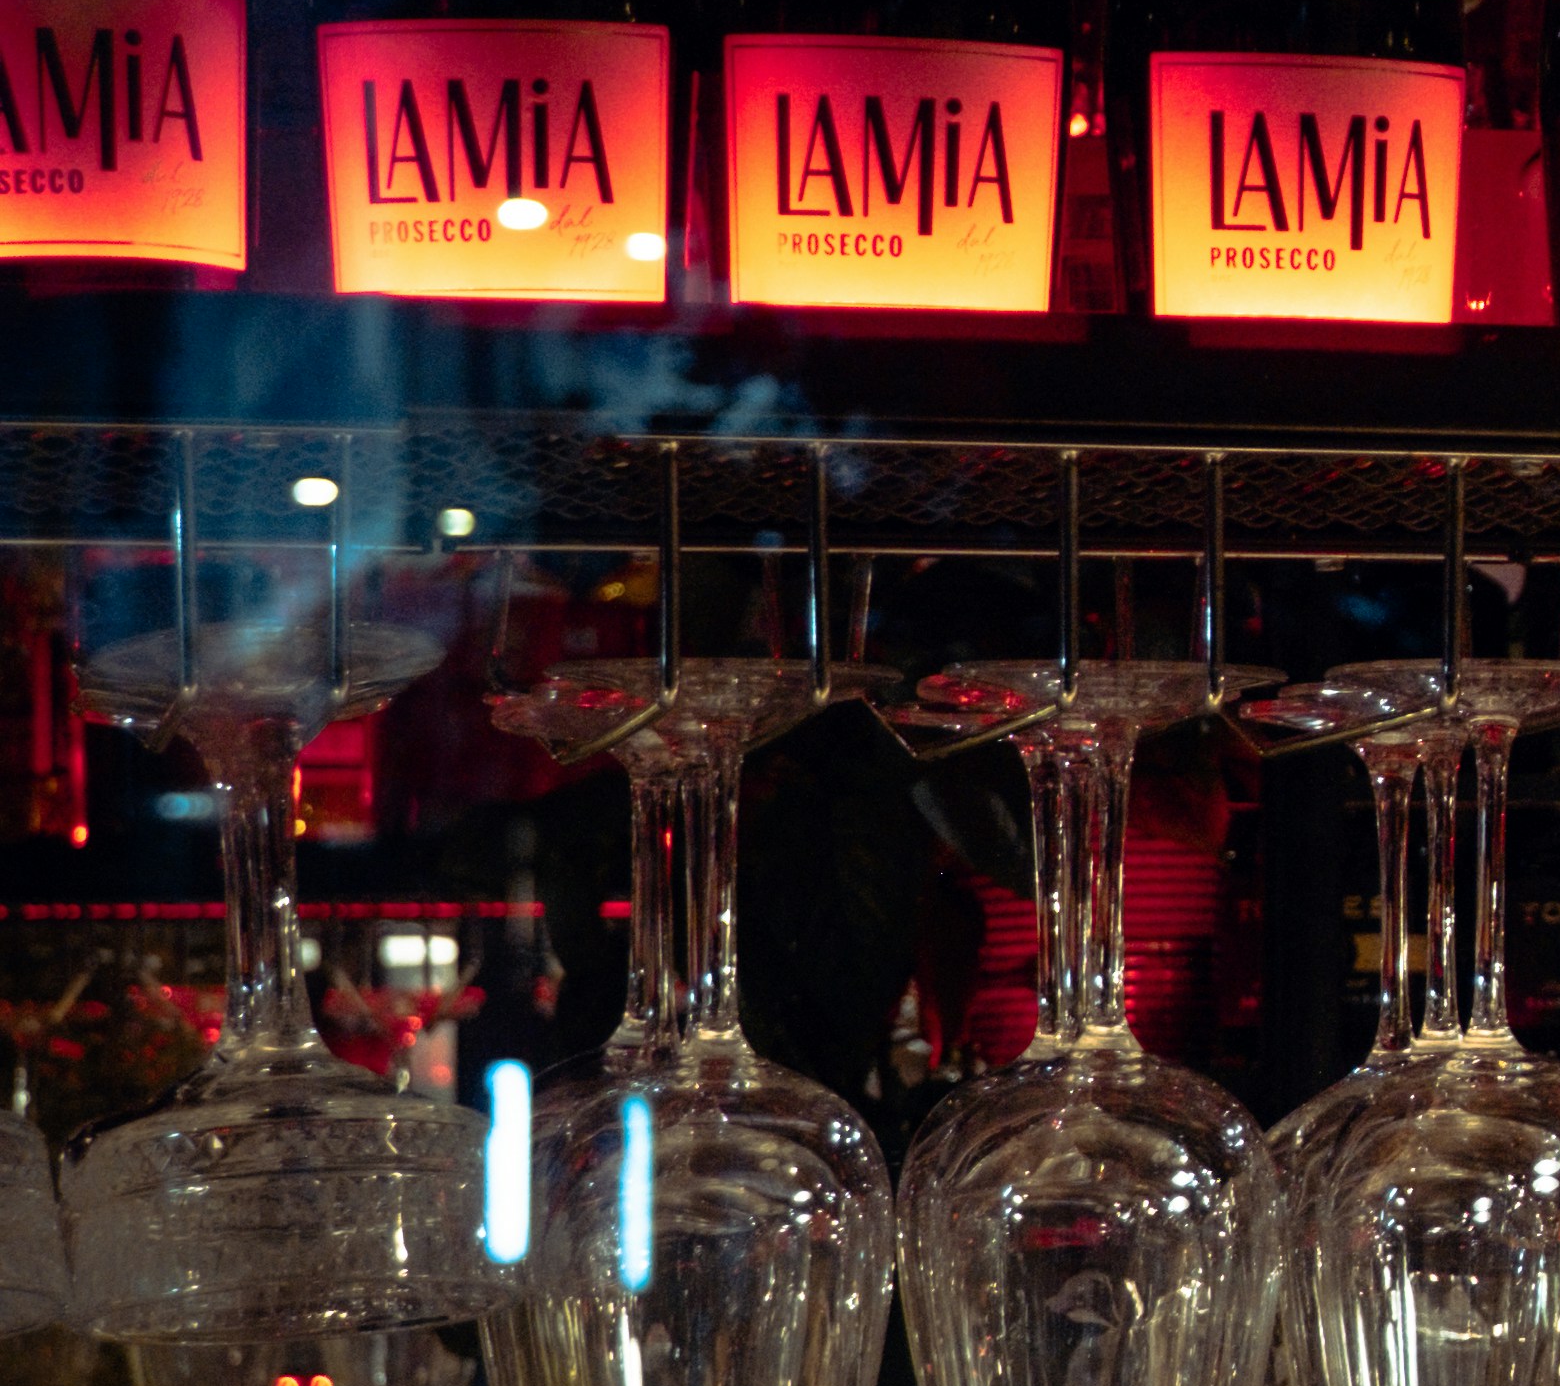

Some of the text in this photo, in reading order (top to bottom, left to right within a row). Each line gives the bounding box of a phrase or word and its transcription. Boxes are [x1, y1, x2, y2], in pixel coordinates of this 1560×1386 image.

[0, 27, 203, 171] AMiA
[0, 169, 84, 194] SECCO
[368, 219, 492, 245] PROSECCO
[777, 232, 904, 258] PROSECCO
[1210, 246, 1336, 272] PROSECCO
